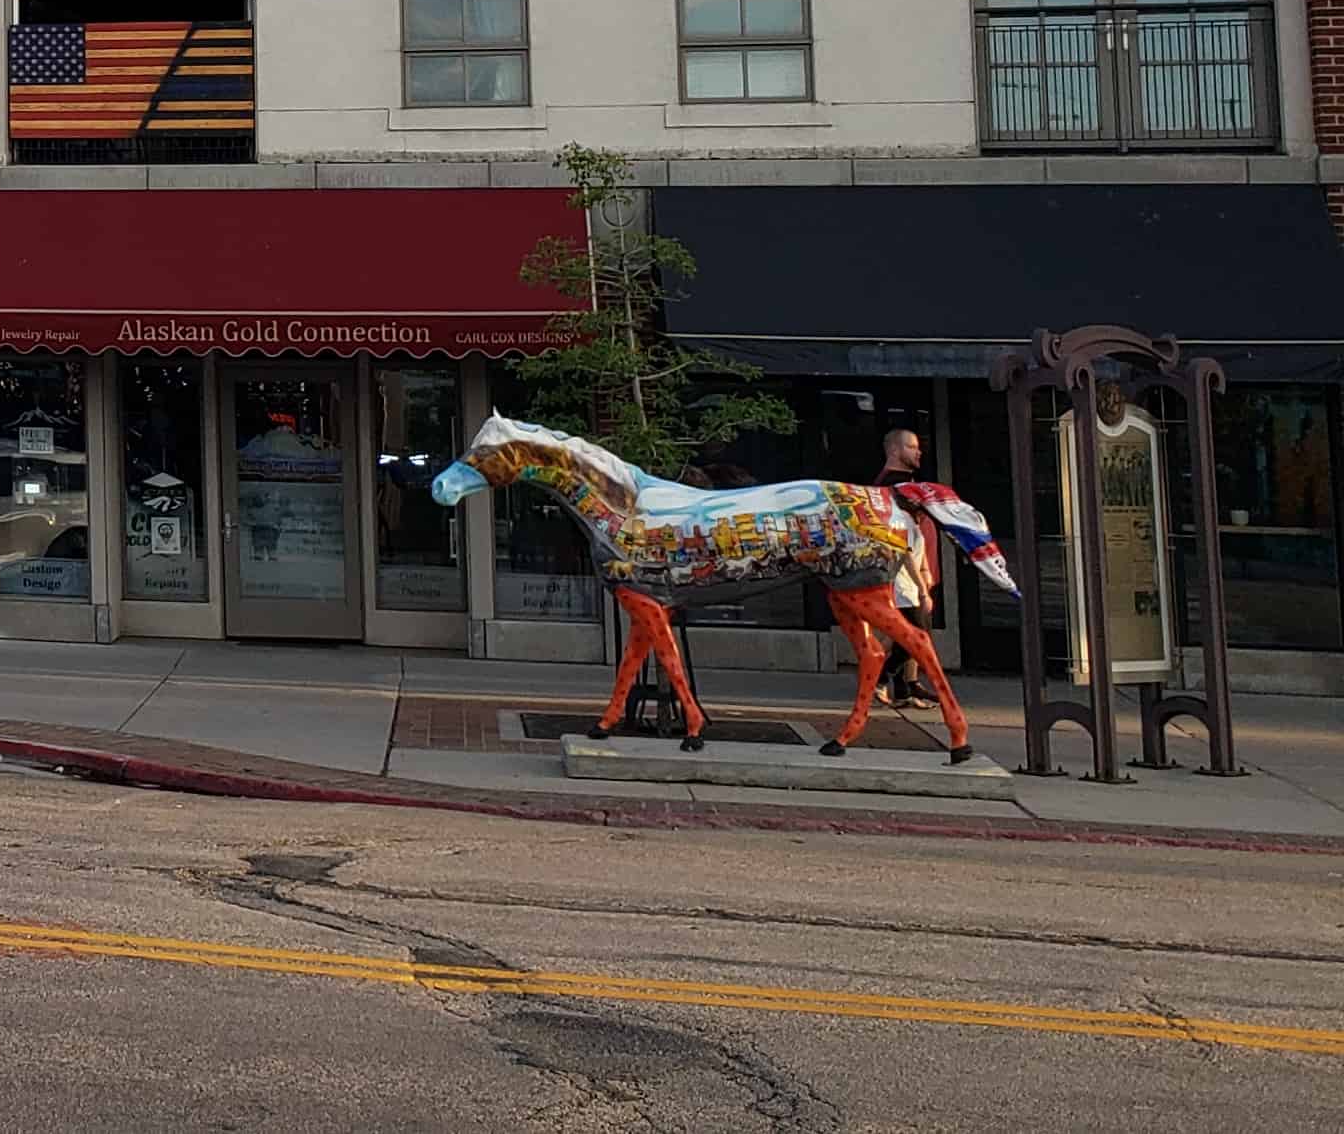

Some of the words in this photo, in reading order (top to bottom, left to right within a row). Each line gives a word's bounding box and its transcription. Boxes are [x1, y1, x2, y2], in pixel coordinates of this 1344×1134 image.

[0, 328, 43, 343] Jewelry
[44, 329, 81, 343] Repair
[116, 319, 215, 341] Alaskan
[222, 320, 280, 343] Gold
[286, 320, 432, 344] Connection
[455, 331, 489, 344] CARL
[490, 332, 516, 345] COX
